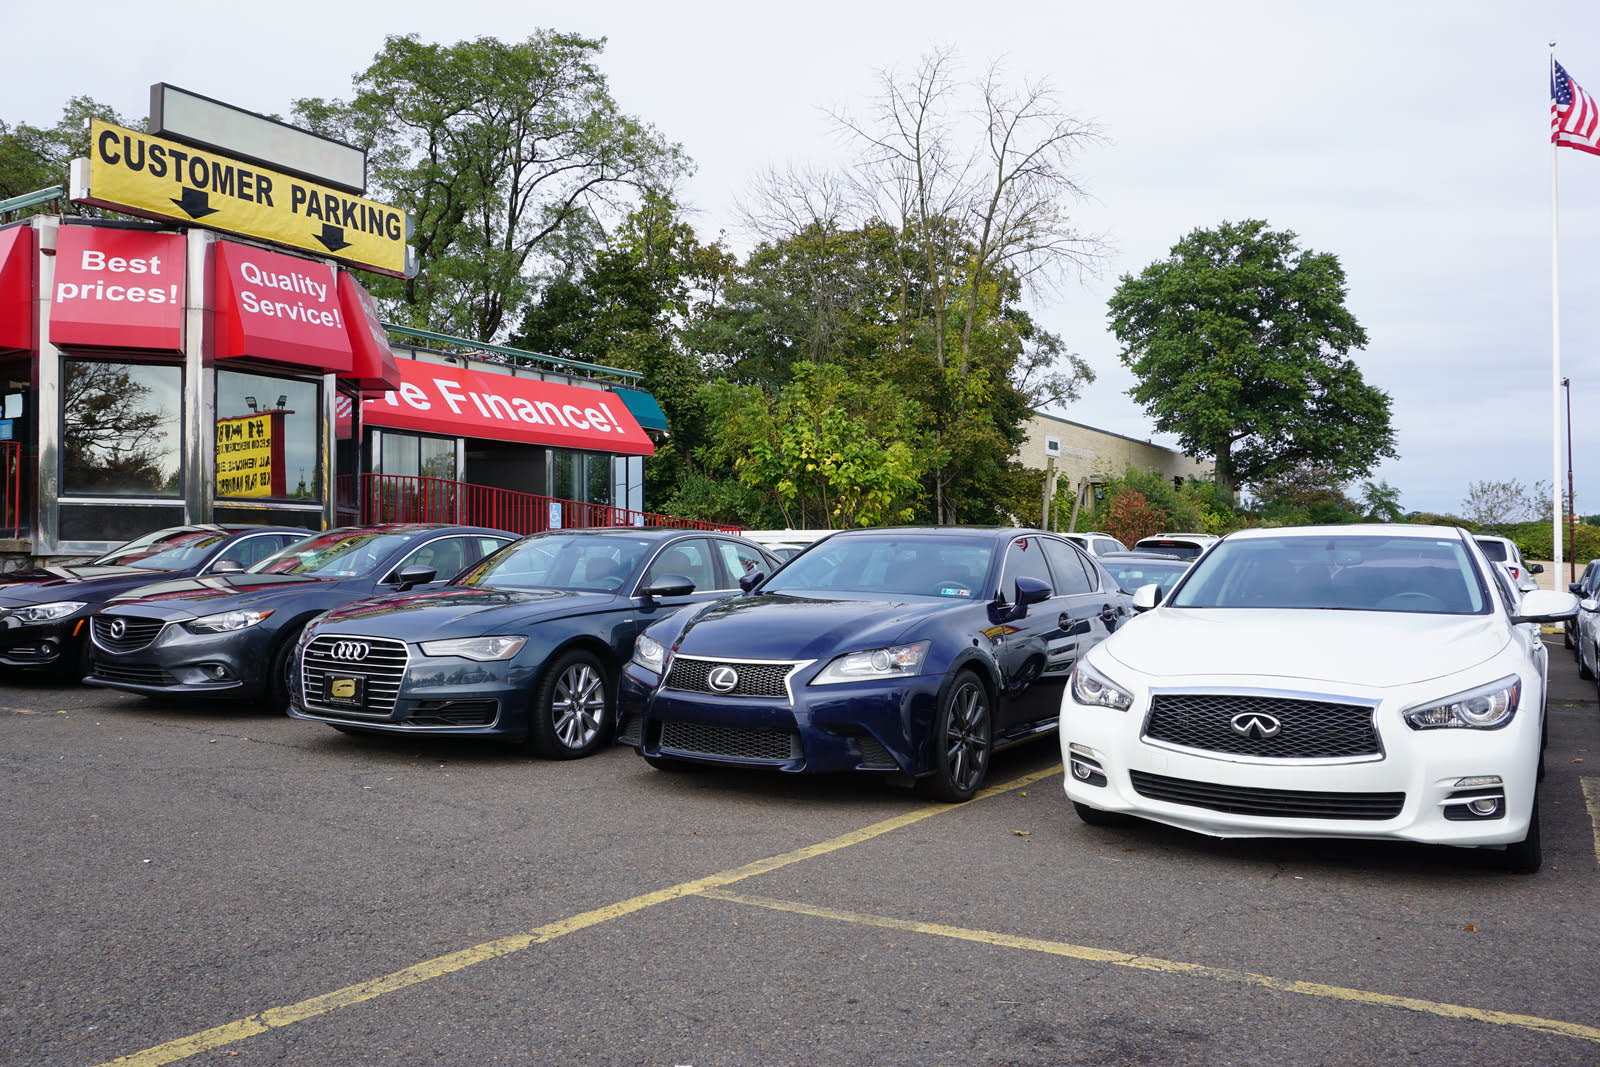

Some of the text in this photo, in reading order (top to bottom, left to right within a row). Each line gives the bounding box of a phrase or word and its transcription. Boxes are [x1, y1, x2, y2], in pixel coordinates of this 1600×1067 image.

[98, 129, 401, 241] CUSTOMER PARKING
[81, 250, 161, 275] Best
[57, 280, 178, 304] prices!
[240, 262, 327, 303] Quality
[240, 291, 342, 329] Service!
[432, 378, 625, 434] Finance!
